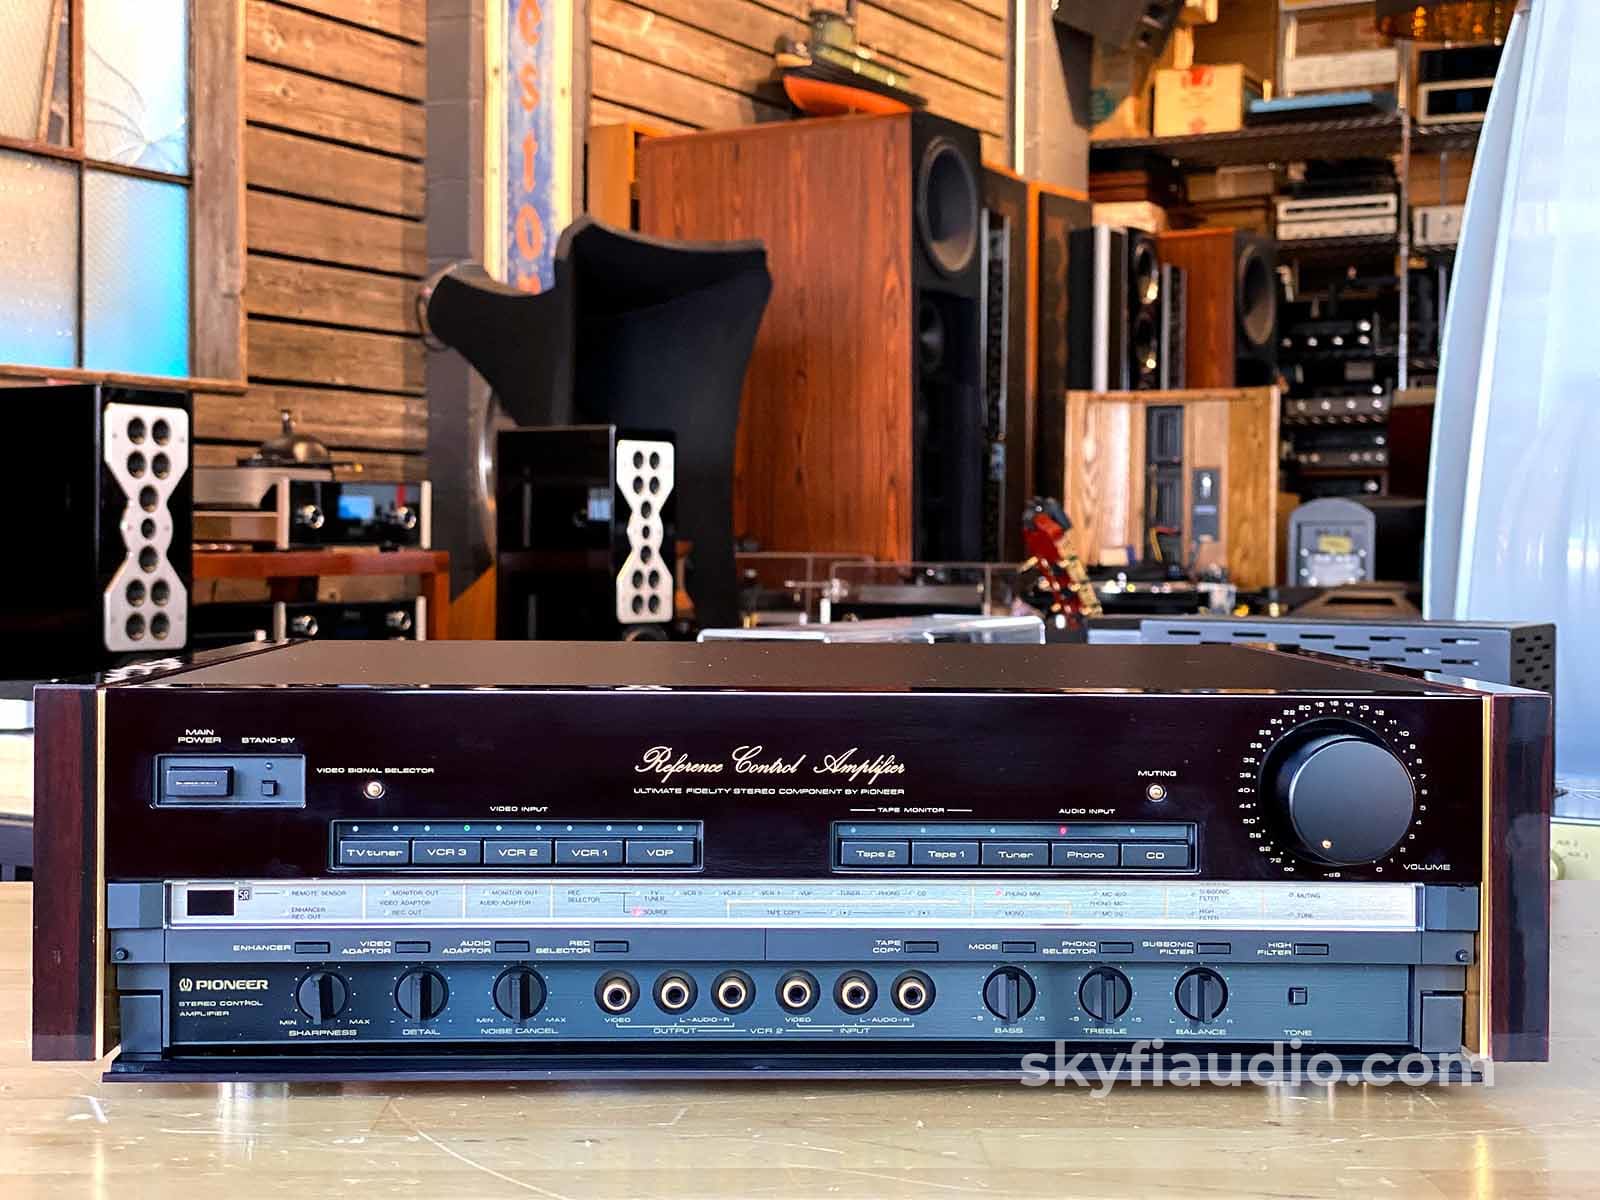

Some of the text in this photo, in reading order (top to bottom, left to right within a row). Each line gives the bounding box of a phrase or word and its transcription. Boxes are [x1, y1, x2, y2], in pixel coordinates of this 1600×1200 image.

[635, 745, 905, 785] Reference Control Amplifier
[427, 848, 467, 856] VCR 3
[498, 848, 539, 856] VCR 2
[571, 849, 608, 857] VCR 1
[856, 850, 896, 859] Tape 2
[927, 850, 966, 859] Tape 1
[998, 851, 1033, 859] Tuner
[1067, 851, 1105, 859] Phono
[1146, 852, 1165, 860] CD
[196, 979, 269, 990] PIONEER
[288, 1029, 357, 1037] SHARPNESS
[402, 1028, 441, 1036] DETAIL
[1083, 1027, 1128, 1035] TREBLE
[1176, 1028, 1227, 1036] BALANCE
[1283, 1029, 1313, 1037] TONE
